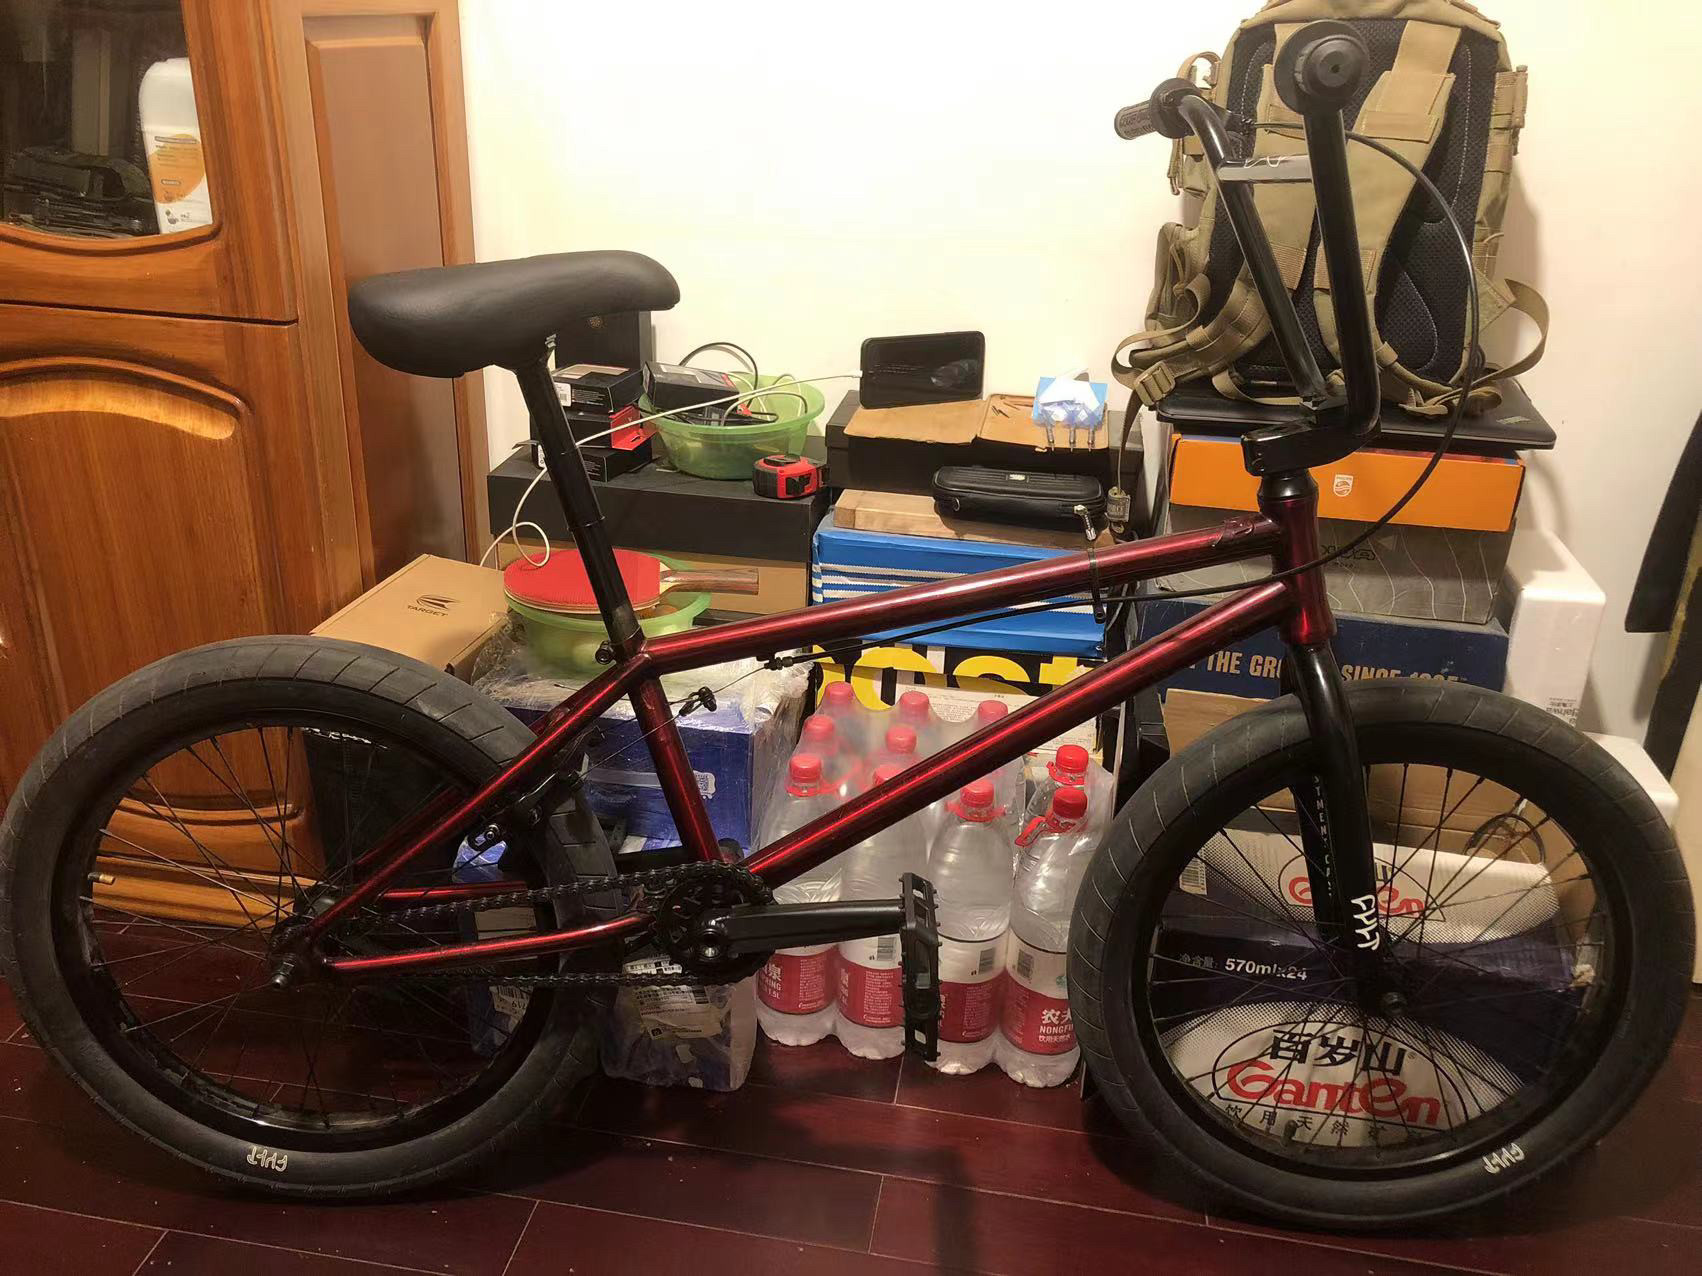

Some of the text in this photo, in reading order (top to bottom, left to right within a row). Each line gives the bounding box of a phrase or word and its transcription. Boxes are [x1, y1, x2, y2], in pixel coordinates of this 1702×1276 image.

[407, 604, 449, 616] TARGET
[1207, 650, 1243, 674] THE
[1269, 1028, 1408, 1077] 百岁山
[1226, 1059, 1442, 1126] Ganten
